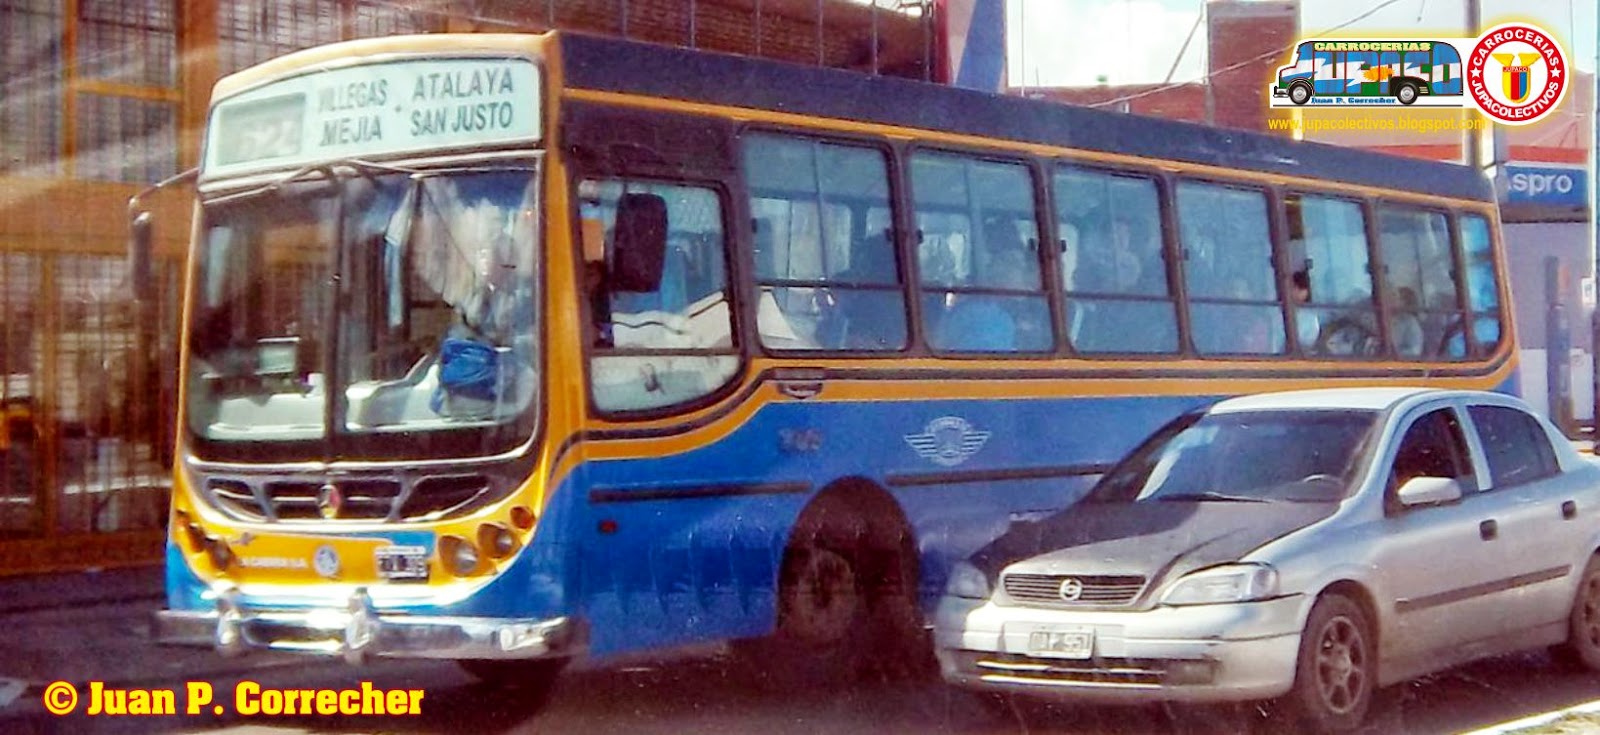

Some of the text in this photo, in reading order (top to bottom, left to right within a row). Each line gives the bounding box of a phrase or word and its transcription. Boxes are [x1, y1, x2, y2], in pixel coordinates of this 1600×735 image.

[412, 67, 513, 101] ATALAYA
[319, 115, 382, 147] MEJIA
[411, 101, 513, 137] SAN JUSTO
[1508, 173, 1573, 196] spro
